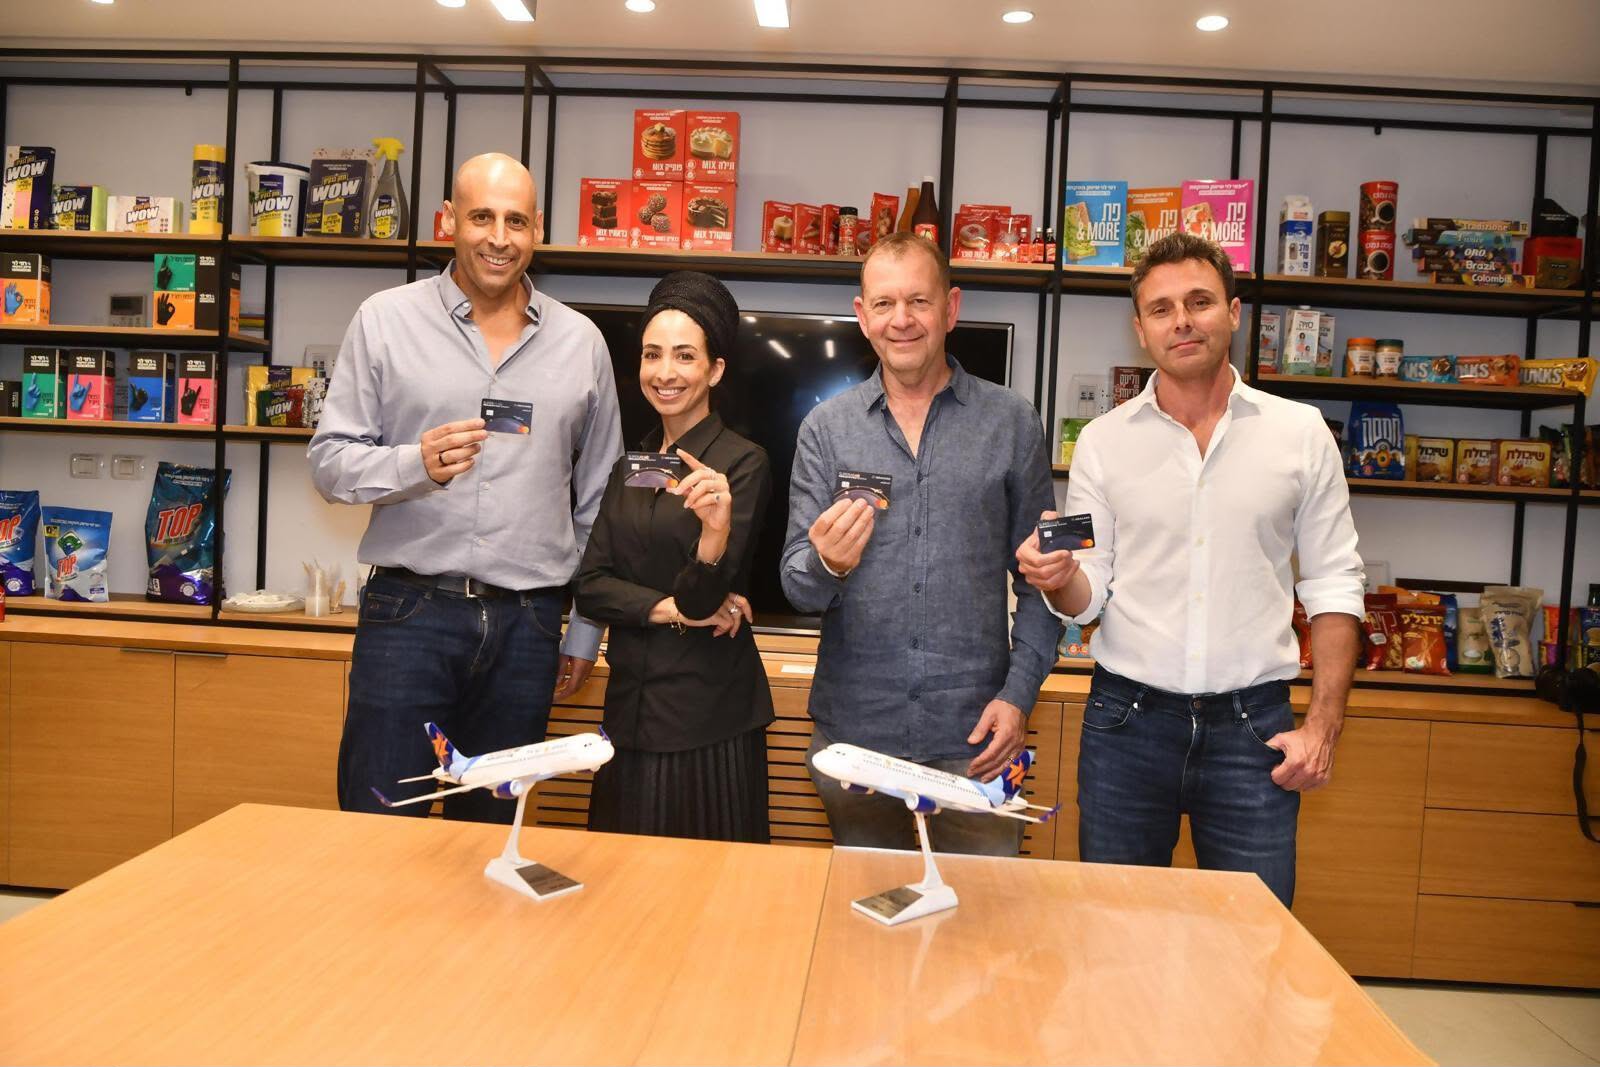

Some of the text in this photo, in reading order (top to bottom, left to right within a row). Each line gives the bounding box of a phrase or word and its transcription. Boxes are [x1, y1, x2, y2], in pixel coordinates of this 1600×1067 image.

[7, 161, 46, 181] WOW
[652, 163, 664, 171] MIX
[701, 160, 716, 170] MIX
[312, 180, 360, 202] WOW
[51, 197, 85, 215] WOW
[253, 196, 293, 215] WOW
[375, 207, 395, 217] WOW
[1102, 202, 1121, 221] פת
[1226, 202, 1247, 221] פת
[127, 207, 159, 223] WOW
[1158, 209, 1178, 228] פת
[693, 229, 707, 239] MIX
[1076, 221, 1120, 241] & MORE
[1134, 229, 1142, 247] &
[1200, 221, 1245, 241] & MORE
[1465, 260, 1496, 271] Brazil
[265, 401, 292, 417] WOW
[1506, 448, 1545, 461] שיבולת
[158, 503, 203, 543] TOP
[57, 554, 77, 578] TOP
